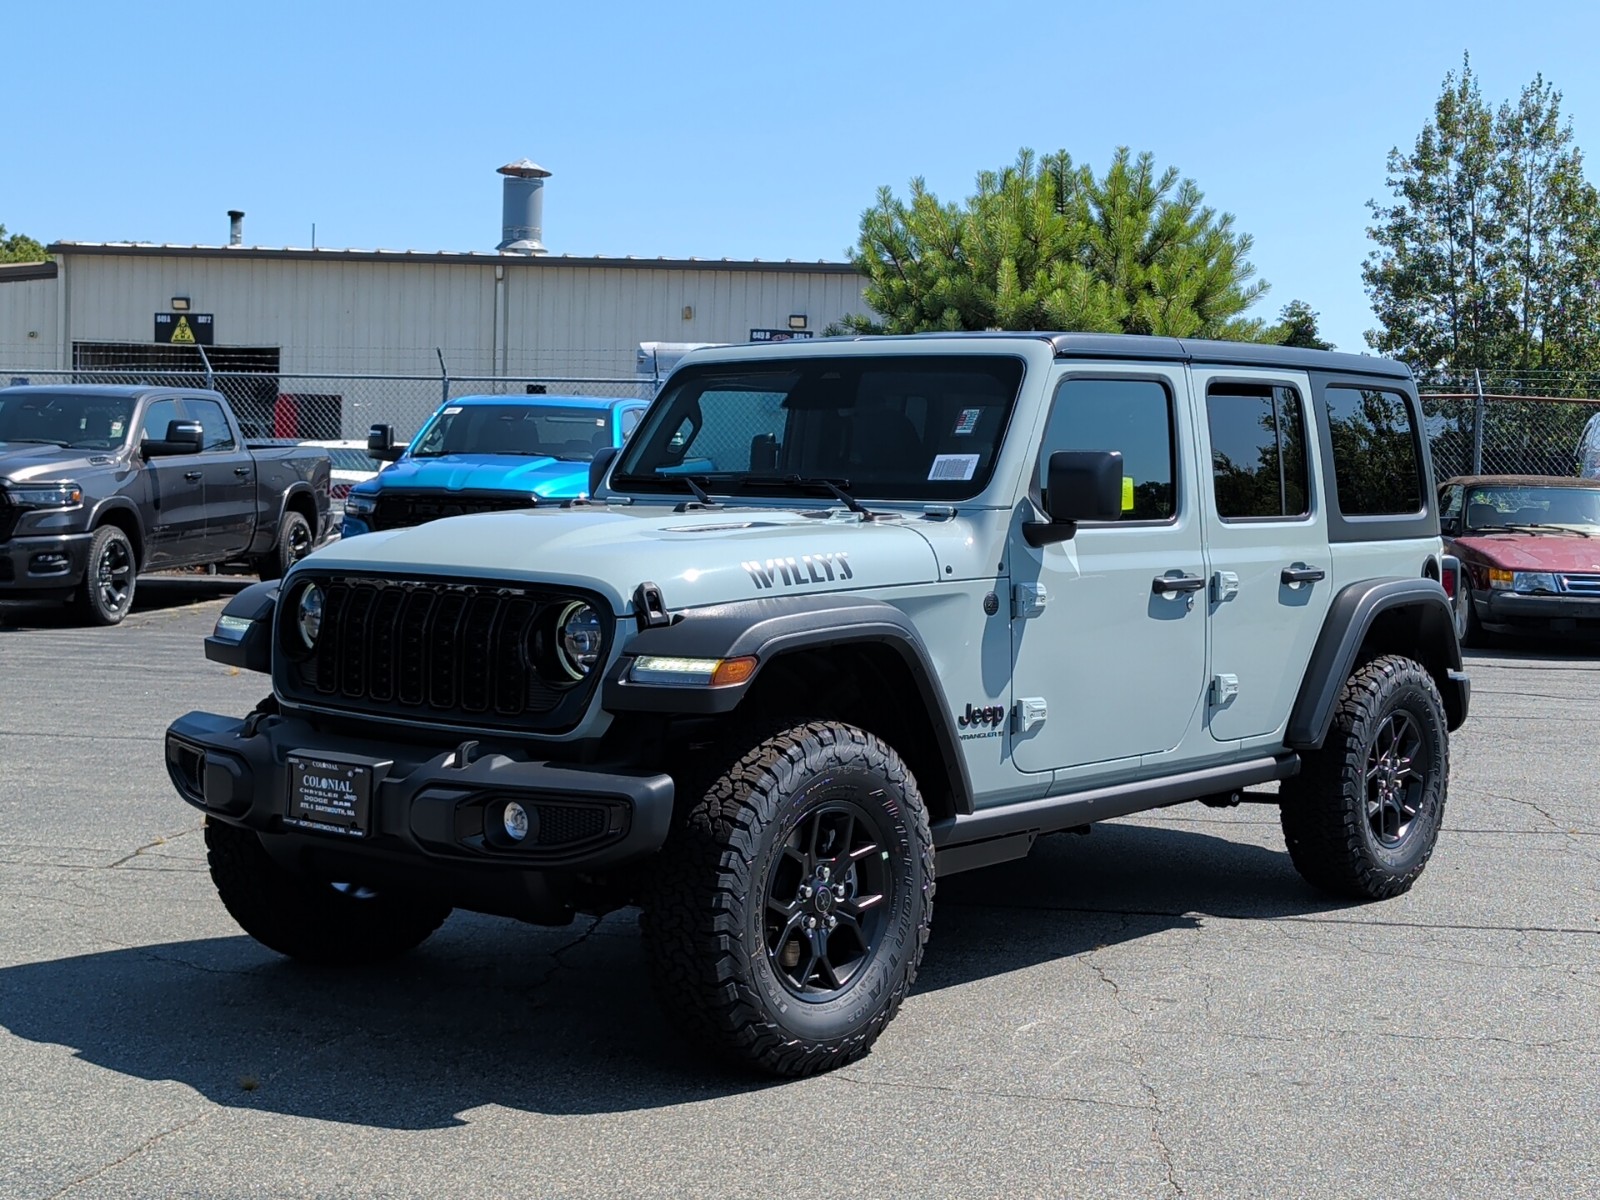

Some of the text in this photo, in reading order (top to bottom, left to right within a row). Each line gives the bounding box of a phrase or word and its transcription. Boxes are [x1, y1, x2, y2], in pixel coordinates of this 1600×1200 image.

[741, 552, 853, 590] WILLYS
[958, 703, 1004, 727] Jeep
[959, 731, 997, 741] WRANGLER
[312, 761, 338, 770] COLONIAL
[303, 775, 352, 792] COLONIAL
[299, 788, 358, 802] CHRYSLER Jeep
[303, 795, 328, 805] DODGE
